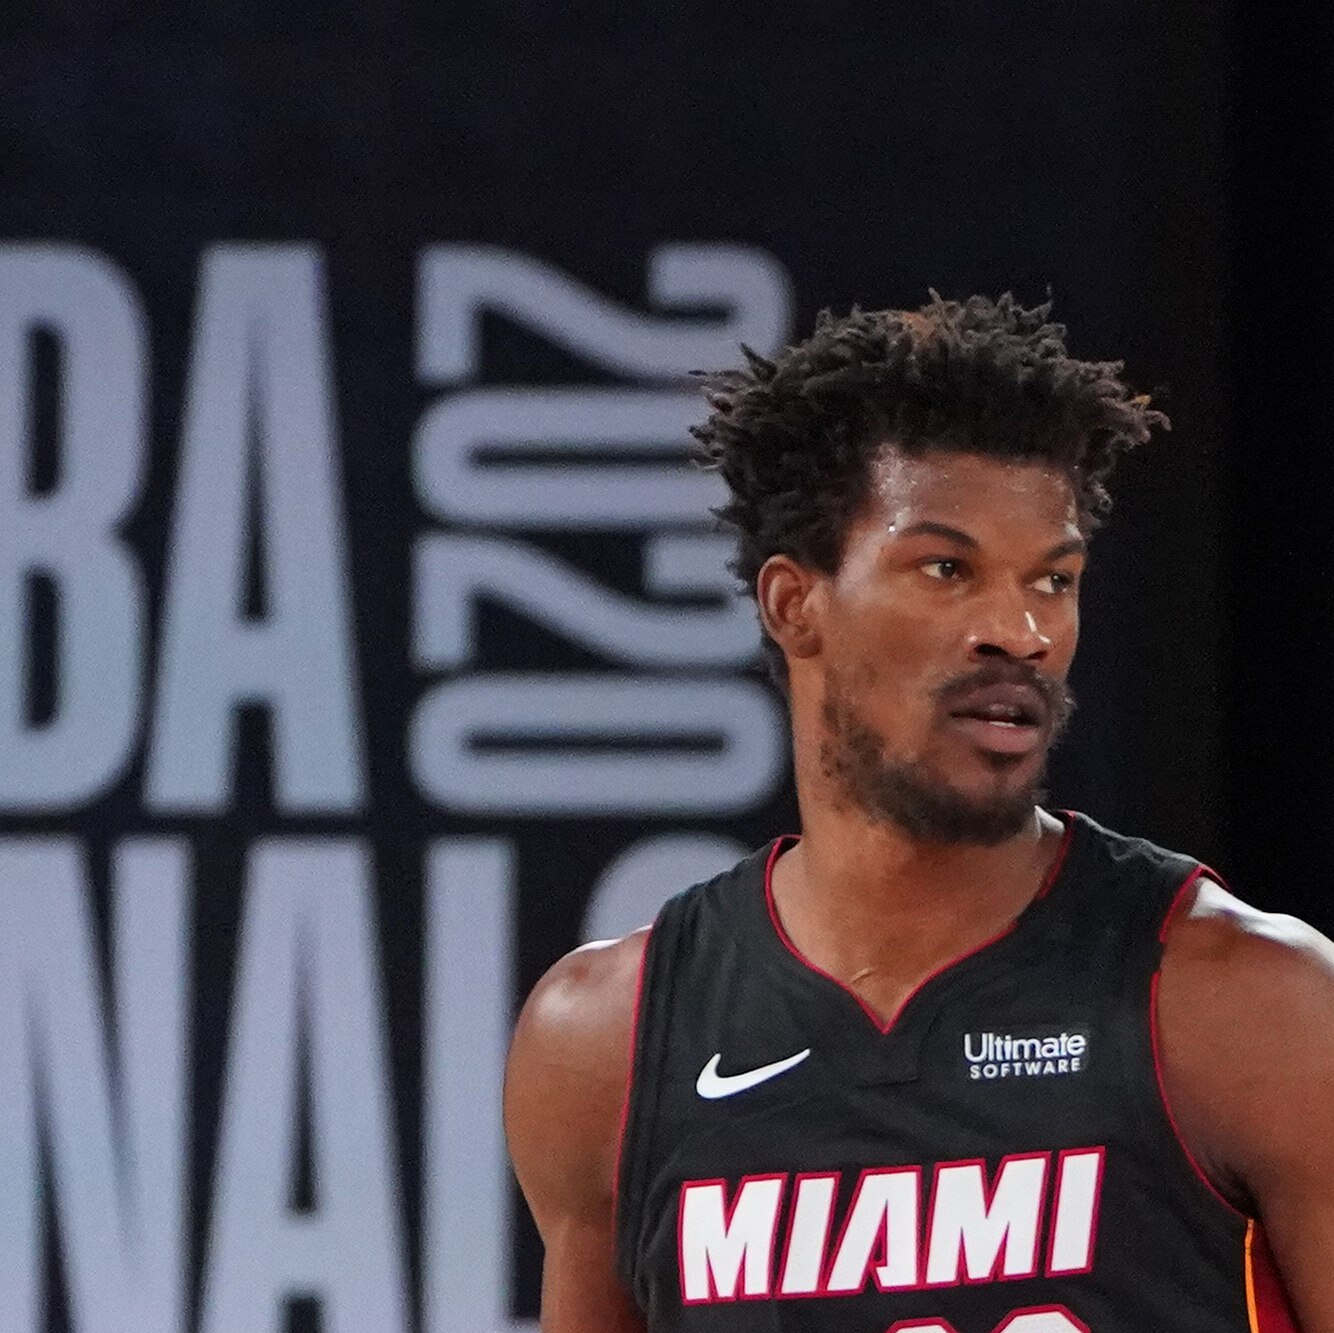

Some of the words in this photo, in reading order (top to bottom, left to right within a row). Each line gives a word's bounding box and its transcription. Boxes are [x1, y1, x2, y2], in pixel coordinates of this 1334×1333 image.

[409, 243, 795, 817] 2020
[964, 1031, 1086, 1062] Ultimate
[969, 1057, 1081, 1080] SOFTWARE
[677, 1145, 1105, 1306] MIAMI
